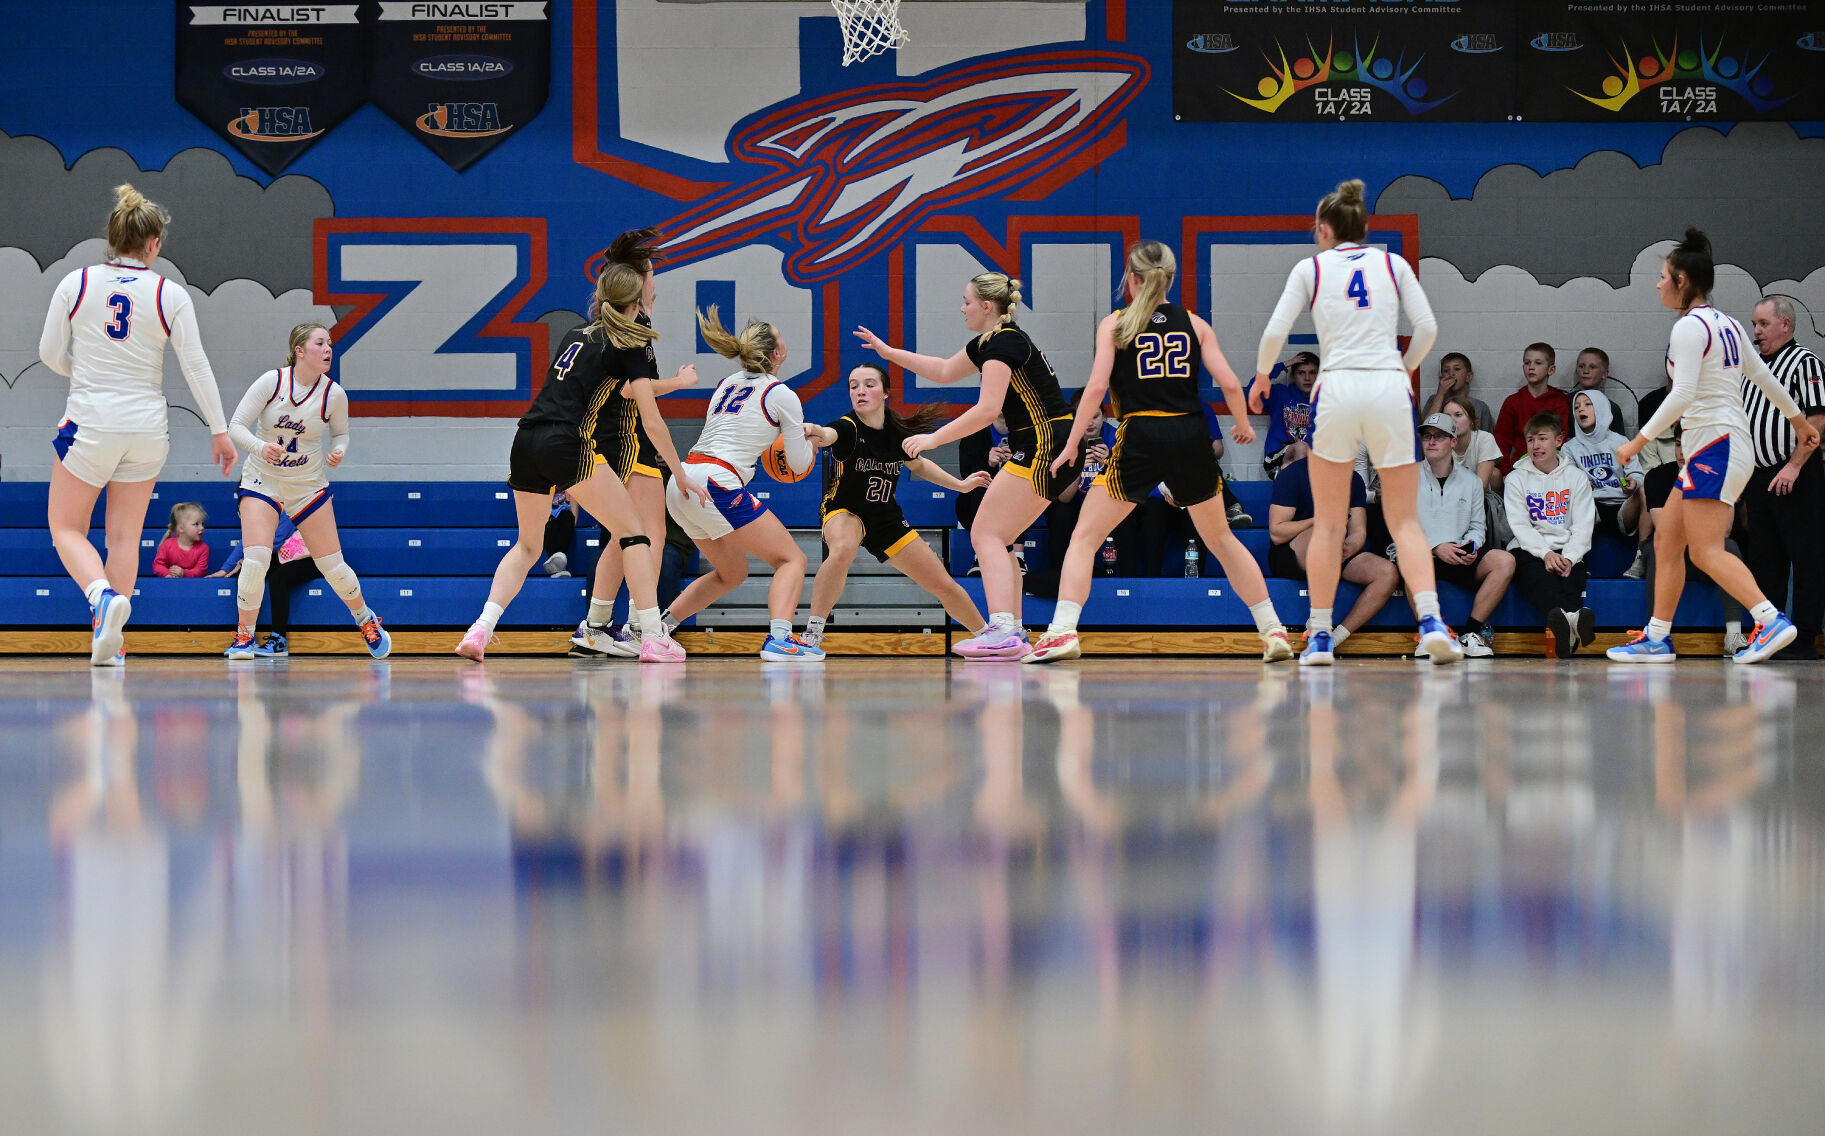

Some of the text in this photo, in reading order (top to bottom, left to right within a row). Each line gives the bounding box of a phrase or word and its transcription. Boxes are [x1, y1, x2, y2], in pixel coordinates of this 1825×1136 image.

[223, 8, 326, 21] FINALIST
[412, 4, 514, 17] FINALIST
[1272, 5, 1283, 14] by
[1369, 6, 1408, 14] Advisory
[1617, 4, 1628, 13] by
[1714, 4, 1754, 12] Advisory
[239, 37, 263, 46] STUDENT
[263, 37, 291, 46] ADVISORY
[292, 37, 323, 46] COMMITTEE
[232, 66, 316, 77] CLASS 1A/2A
[420, 62, 505, 72] CLASS 1A/2A
[1315, 88, 1371, 101] CLASS
[1660, 86, 1716, 100] CLASS
[1345, 267, 1372, 310] 4
[104, 291, 134, 342] 3
[1136, 331, 1191, 378] 22
[1718, 326, 1740, 370] 10
[554, 342, 584, 382] 4
[712, 384, 756, 416] 12
[274, 414, 307, 435] Lady
[776, 450, 789, 476] NCAA
[1580, 452, 1614, 468] UNDER
[866, 476, 892, 503] 21
